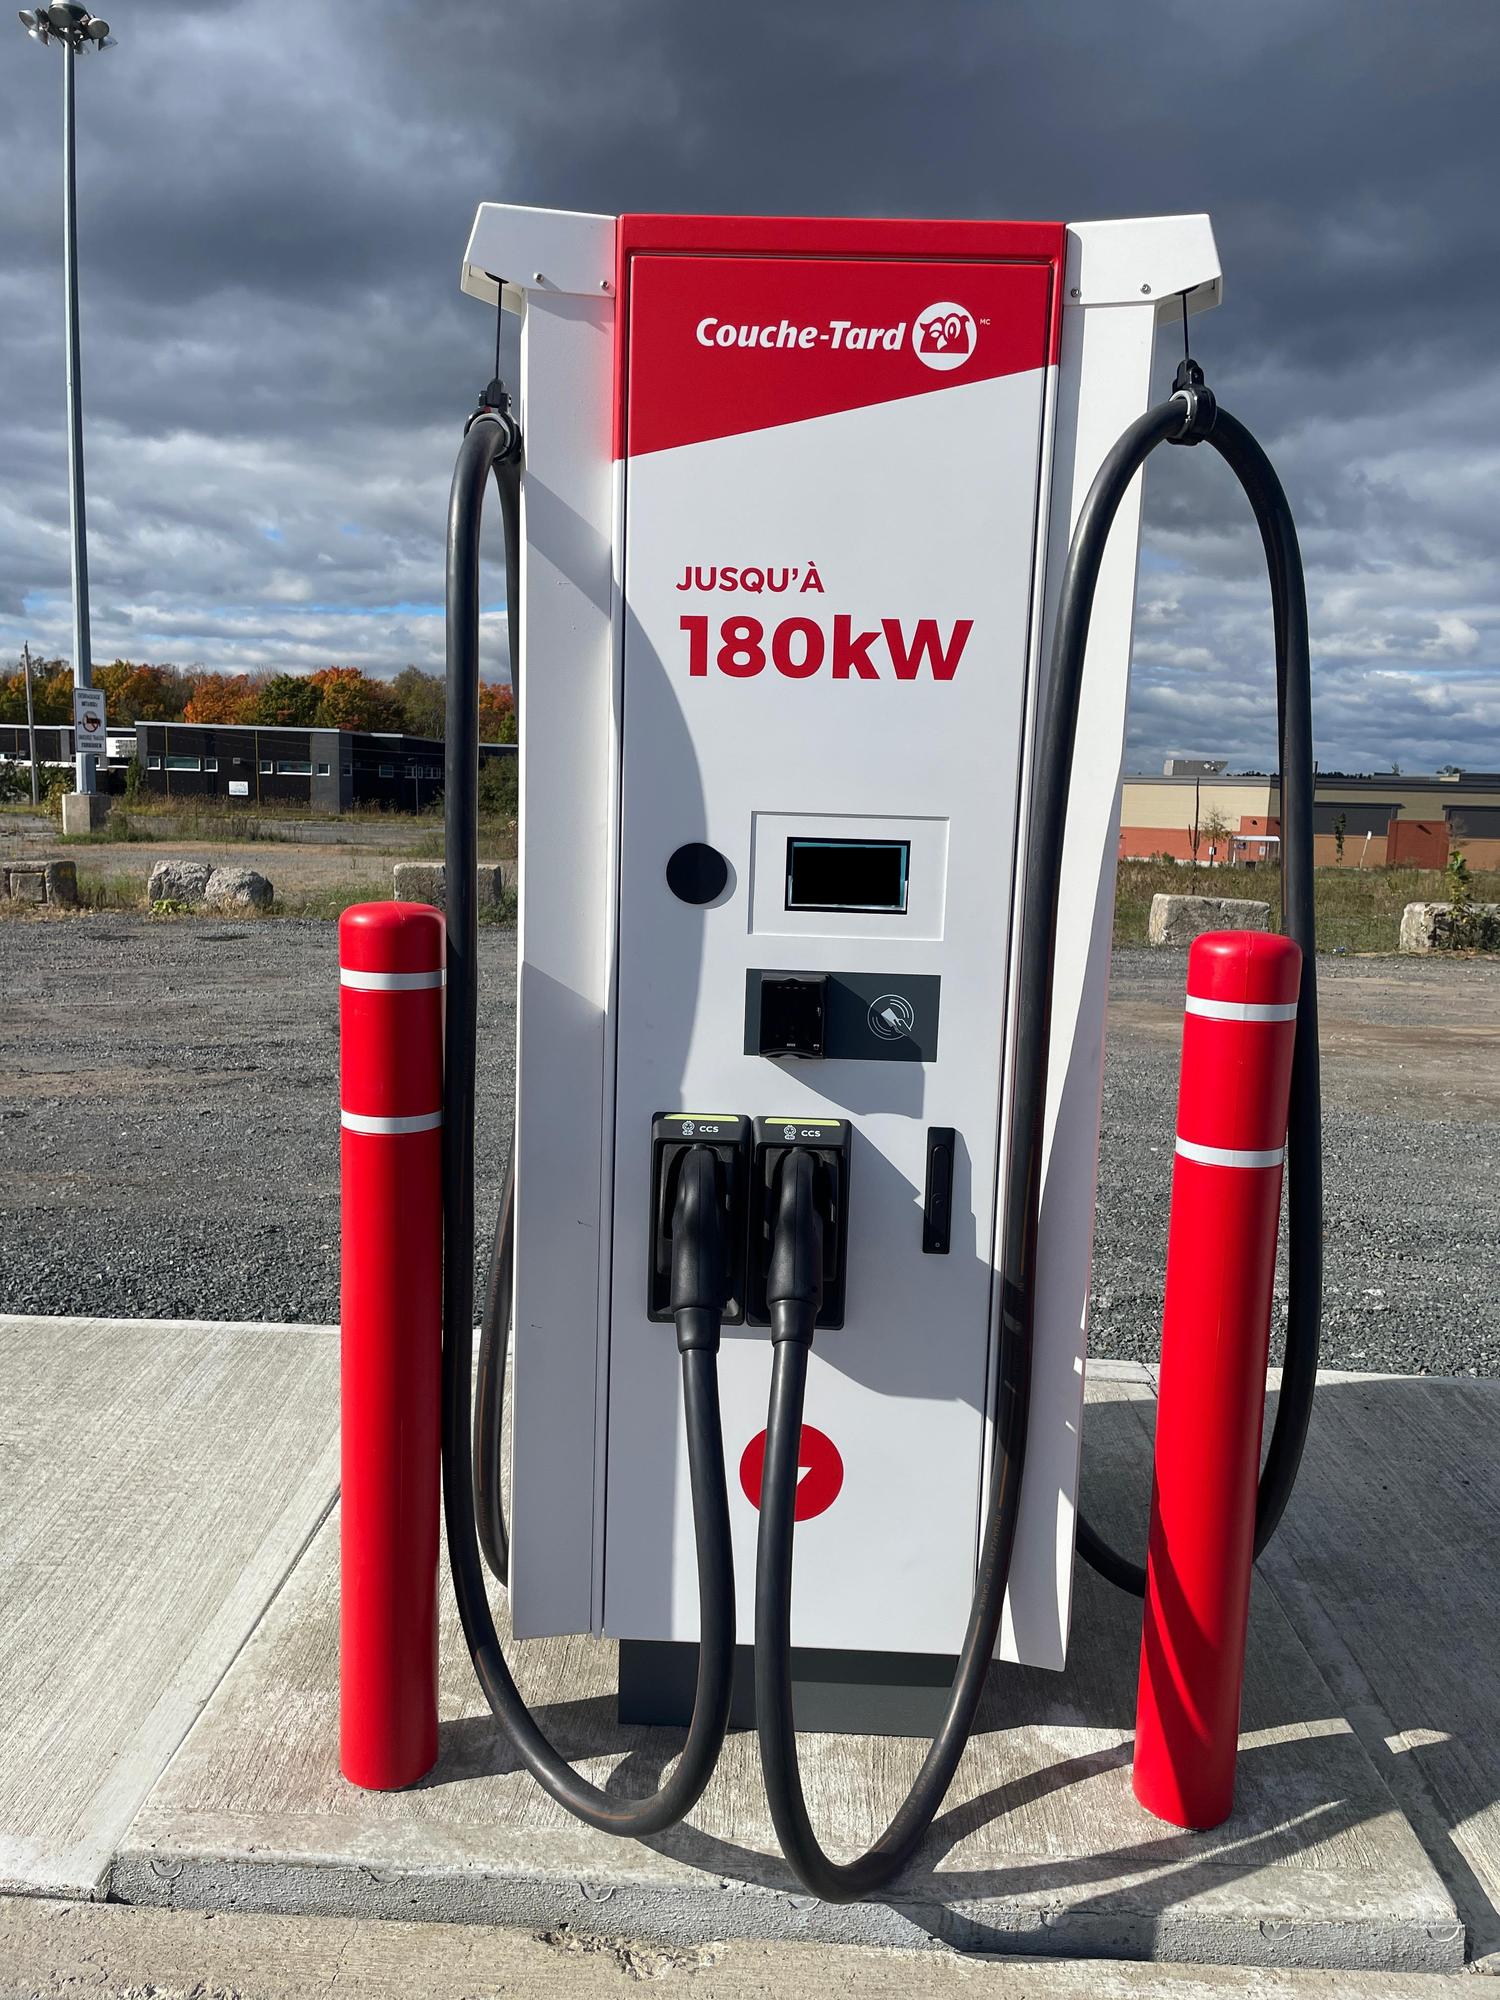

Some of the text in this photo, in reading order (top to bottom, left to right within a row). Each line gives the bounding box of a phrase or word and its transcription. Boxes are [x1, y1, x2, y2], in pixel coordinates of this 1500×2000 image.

[979, 318, 991, 326] MC
[696, 317, 907, 351] Couche-Tard
[676, 561, 825, 594] JUSQU’À
[680, 614, 974, 681] 180kW
[699, 1125, 719, 1133] CCS
[801, 1129, 821, 1138] CCS
